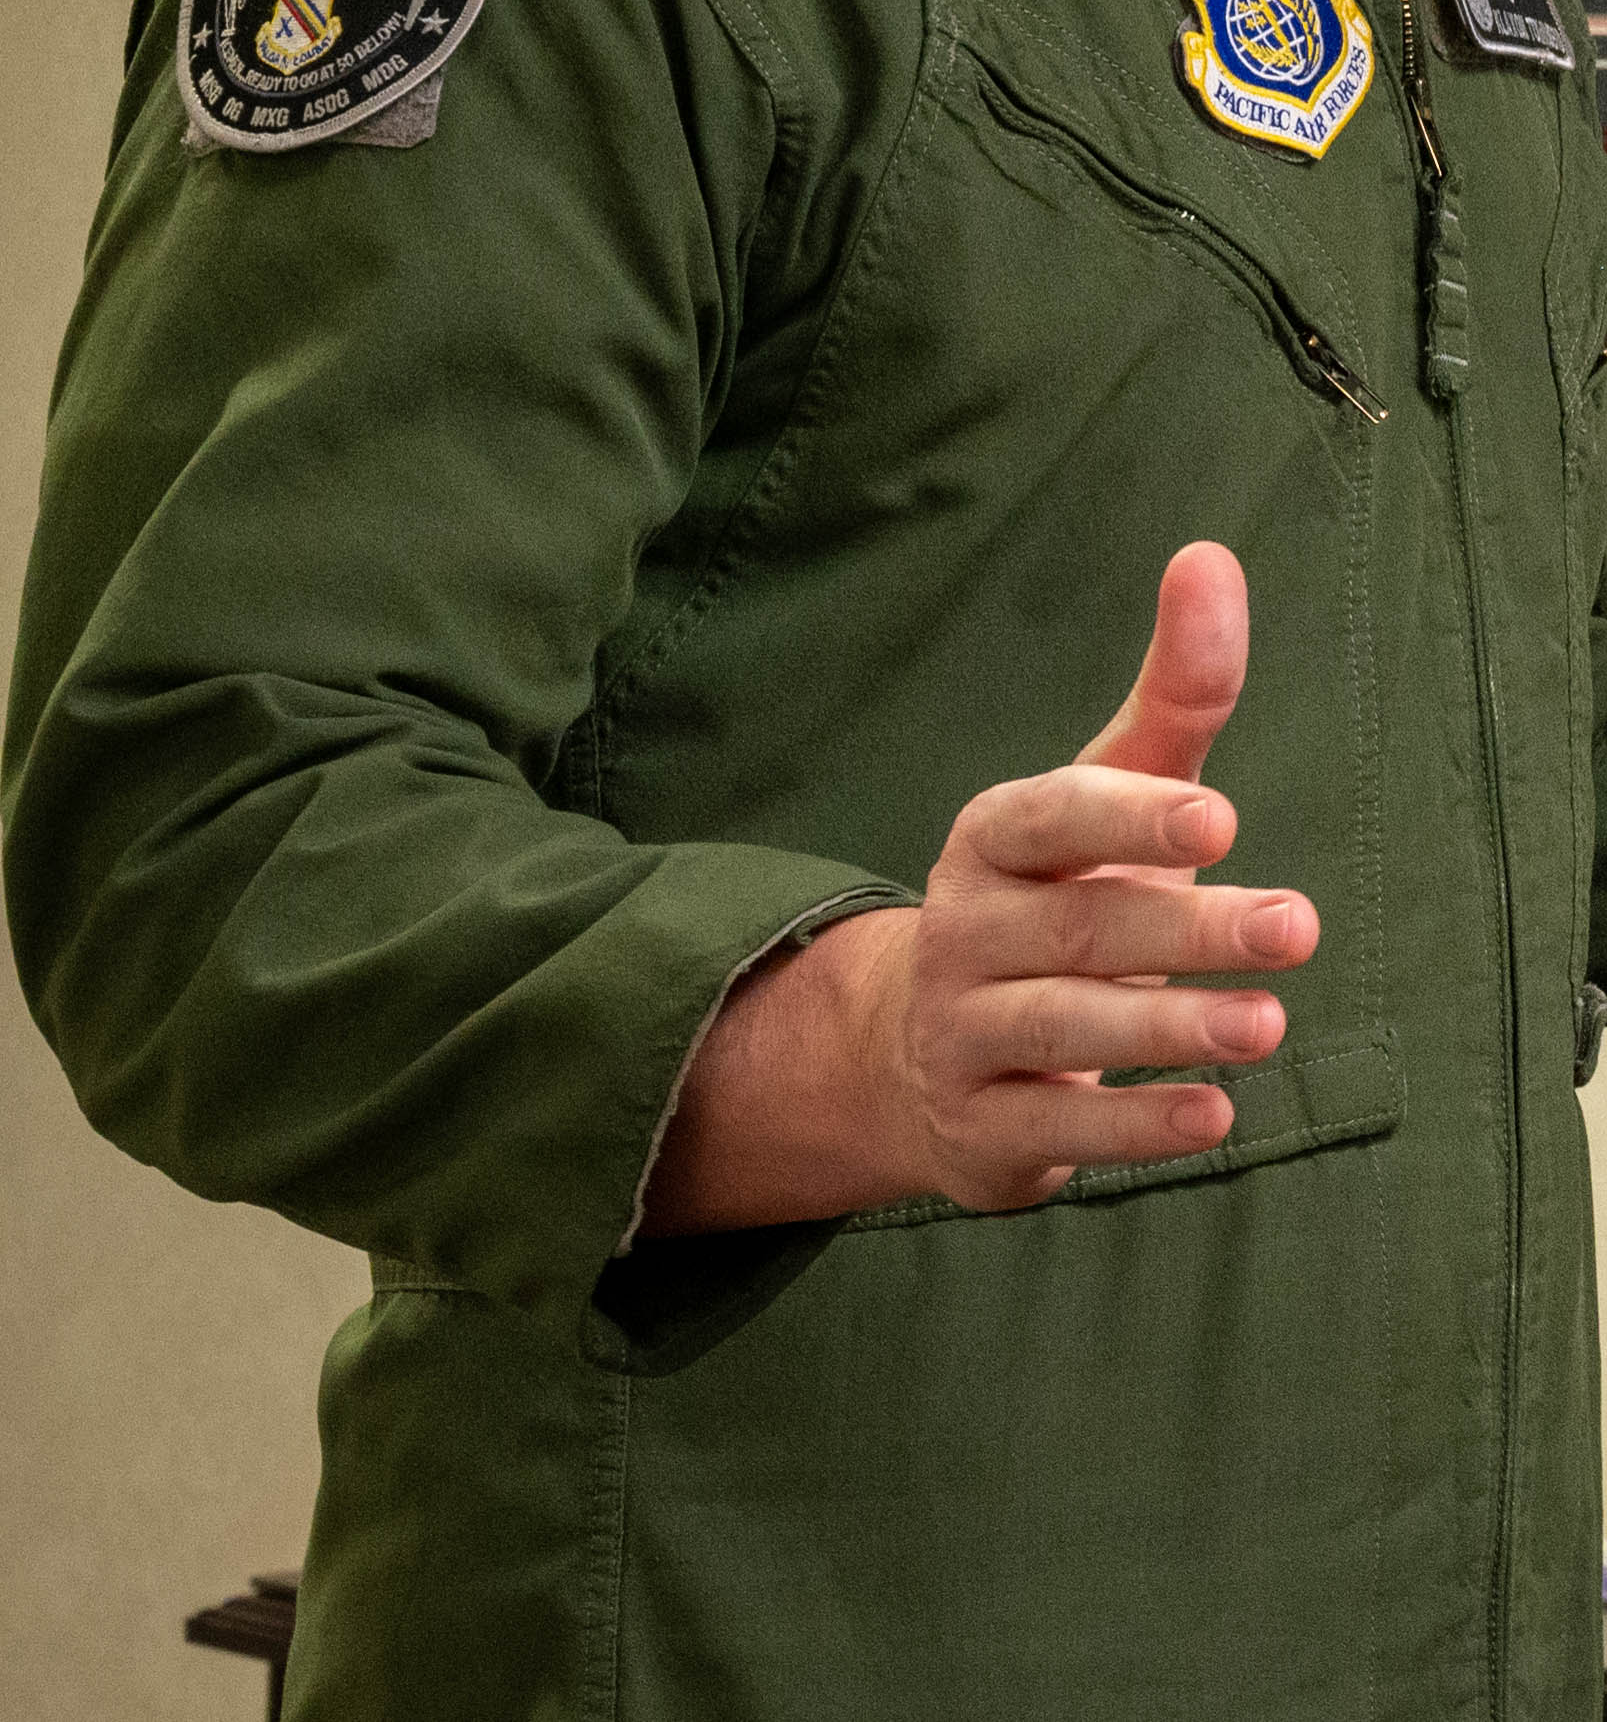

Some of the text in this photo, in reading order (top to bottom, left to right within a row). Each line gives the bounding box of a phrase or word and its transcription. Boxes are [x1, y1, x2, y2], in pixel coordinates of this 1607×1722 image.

[249, 105, 290, 127] MXG
[361, 53, 409, 92] MDG
[282, 76, 298, 92] TO
[319, 62, 336, 82] AT
[336, 52, 355, 73] 50
[1214, 45, 1368, 144] PACIFIC AIR FORCES
